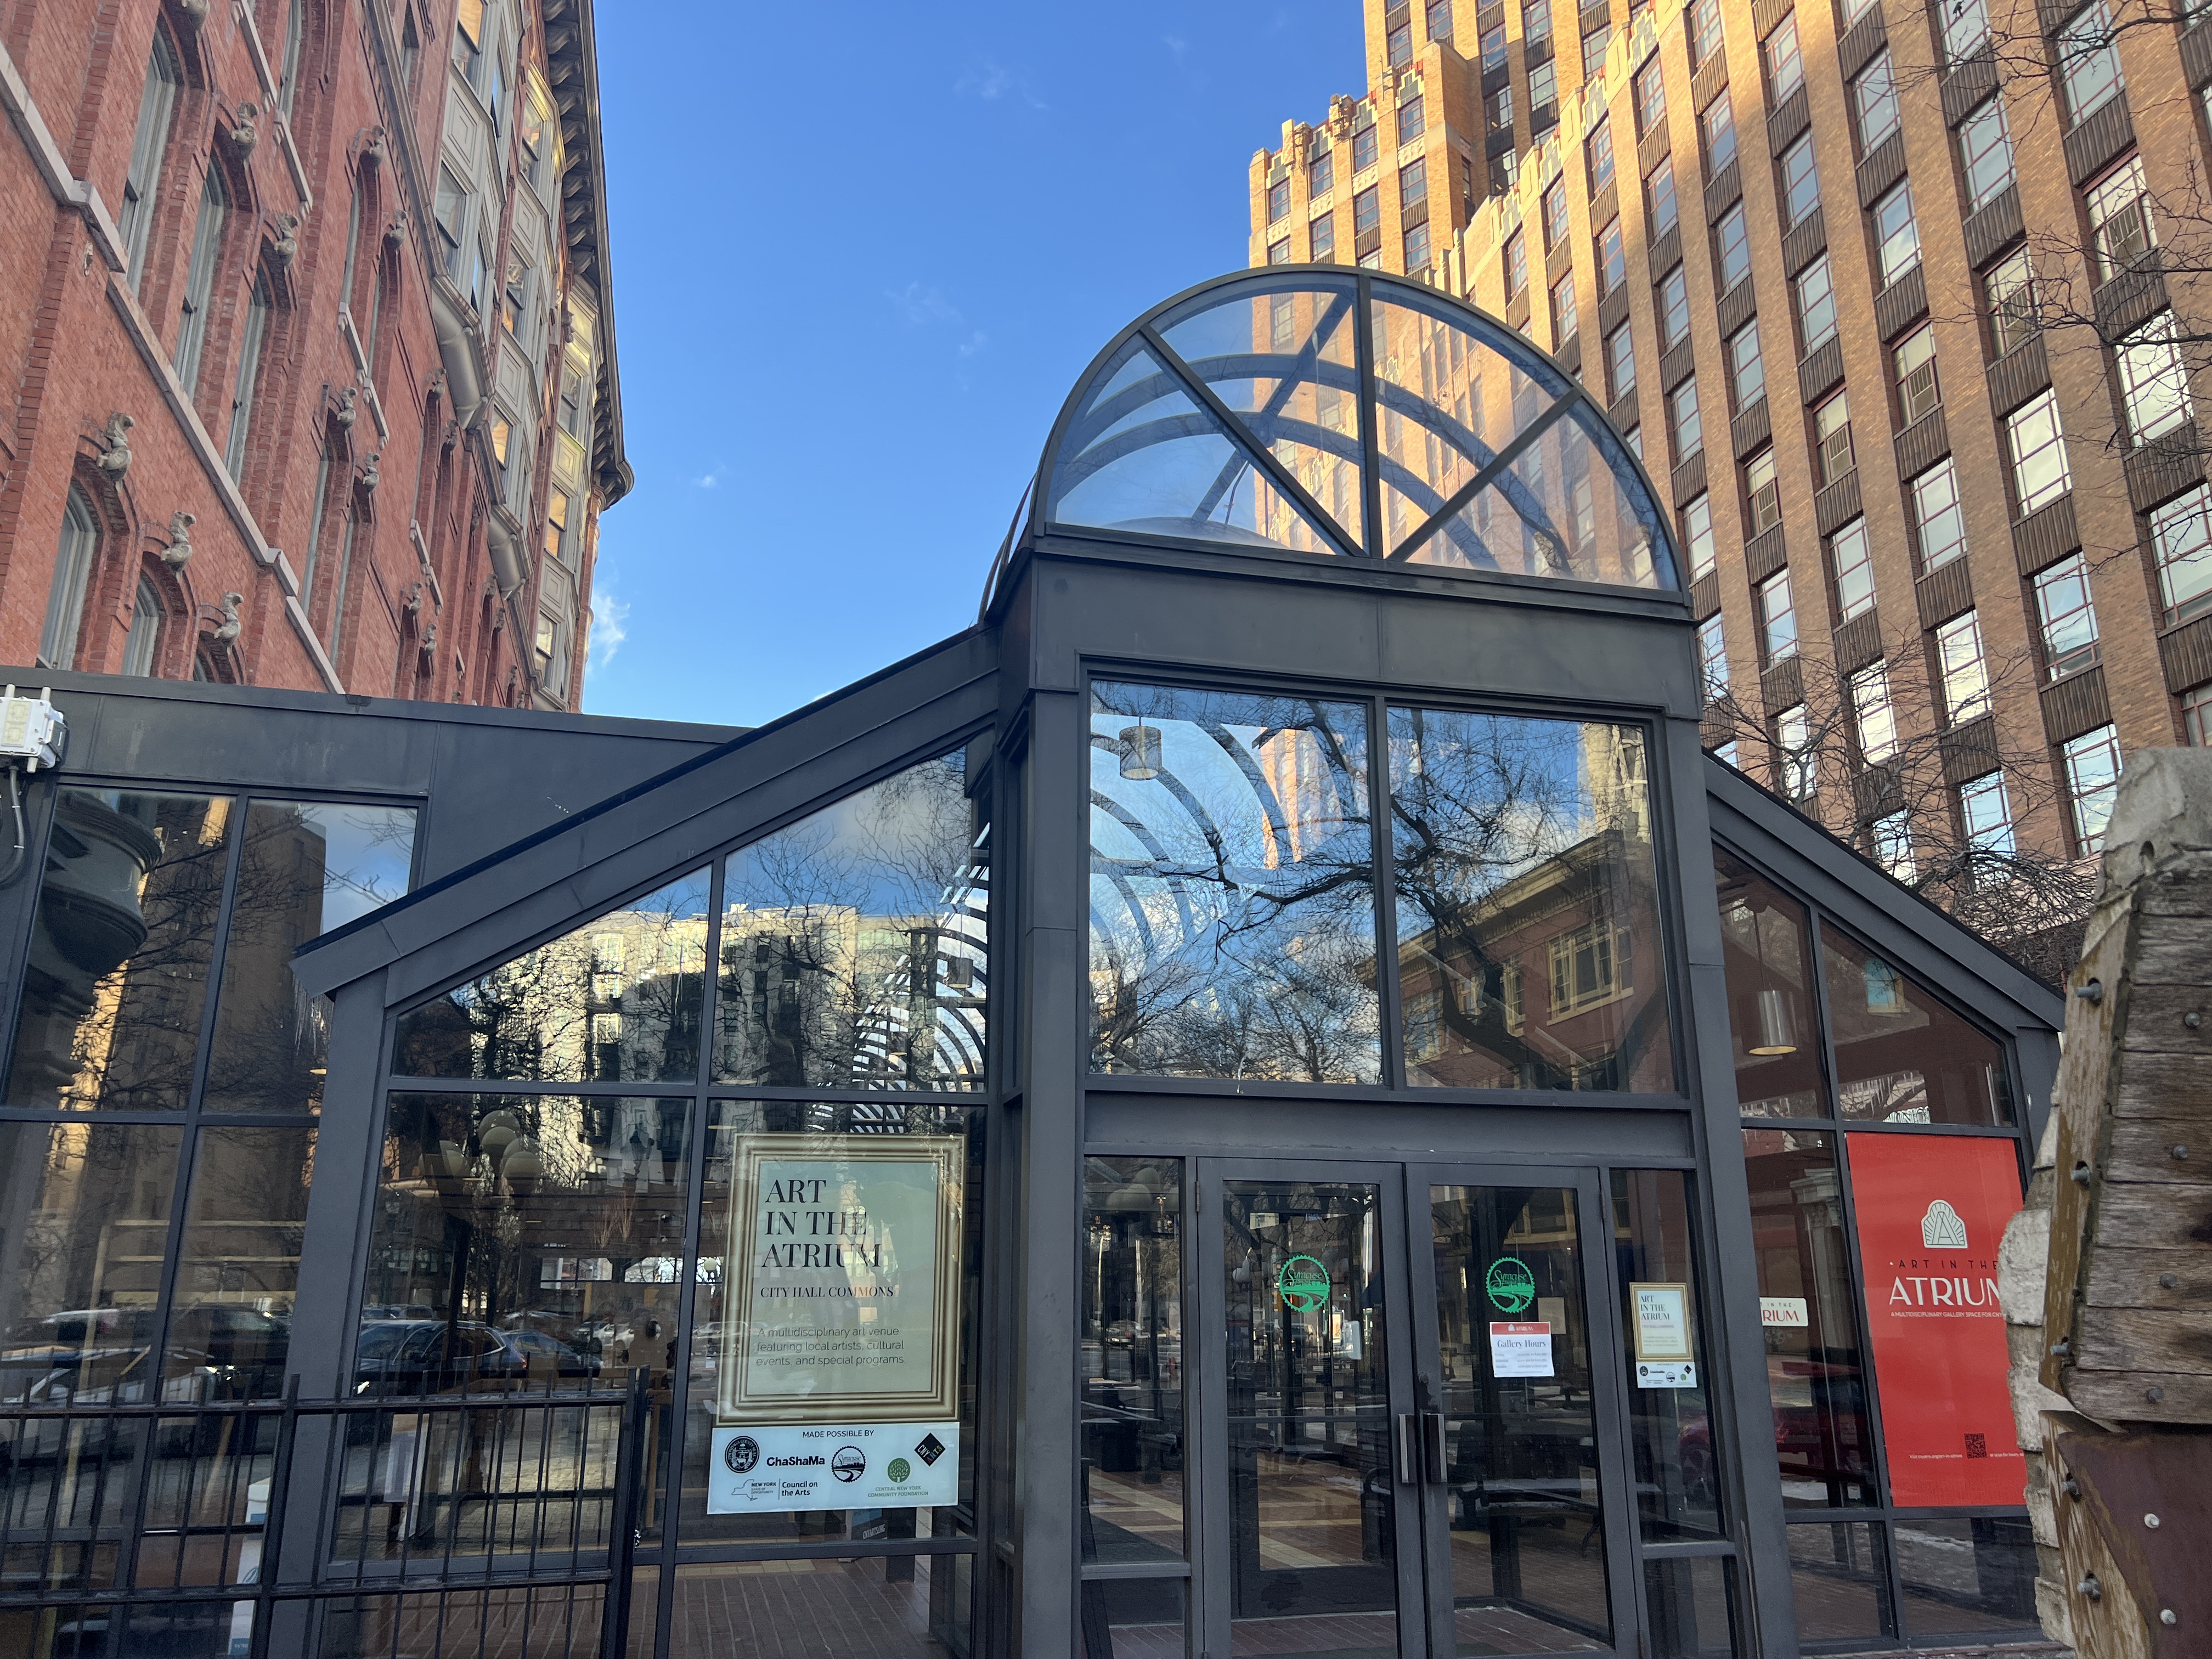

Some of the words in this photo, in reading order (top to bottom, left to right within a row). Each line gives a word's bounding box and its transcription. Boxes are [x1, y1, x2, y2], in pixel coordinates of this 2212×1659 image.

[765, 1179, 827, 1203] ART
[764, 1211, 798, 1235] IN
[805, 1211, 867, 1235] THE
[761, 1243, 883, 1268] ATRIUM
[1899, 1259, 1929, 1269] ART
[1942, 1260, 1957, 1269] IN
[1968, 1260, 1998, 1270] THE
[1287, 1268, 1323, 1286] Syracuse
[1493, 1269, 1527, 1288] Syracuse
[760, 1286, 789, 1298] CITY
[793, 1286, 825, 1298] HALL
[828, 1286, 894, 1298] COMMONS
[758, 1328, 766, 1338] A
[768, 1327, 850, 1339] multidisciplinary
[852, 1327, 866, 1336] art
[868, 1328, 899, 1336] venue
[757, 1341, 802, 1353] featuring
[805, 1341, 830, 1351] local
[832, 1341, 864, 1351] artists,
[867, 1340, 904, 1350] cultural
[1497, 1340, 1523, 1349] Gallery
[1525, 1340, 1547, 1348] Hours
[756, 1357, 793, 1366] events,
[795, 1355, 816, 1365] and
[817, 1355, 854, 1367] special
[856, 1355, 906, 1367] programs.
[917, 1444, 930, 1458] CNY
[766, 1455, 826, 1466] ChaShaMa
